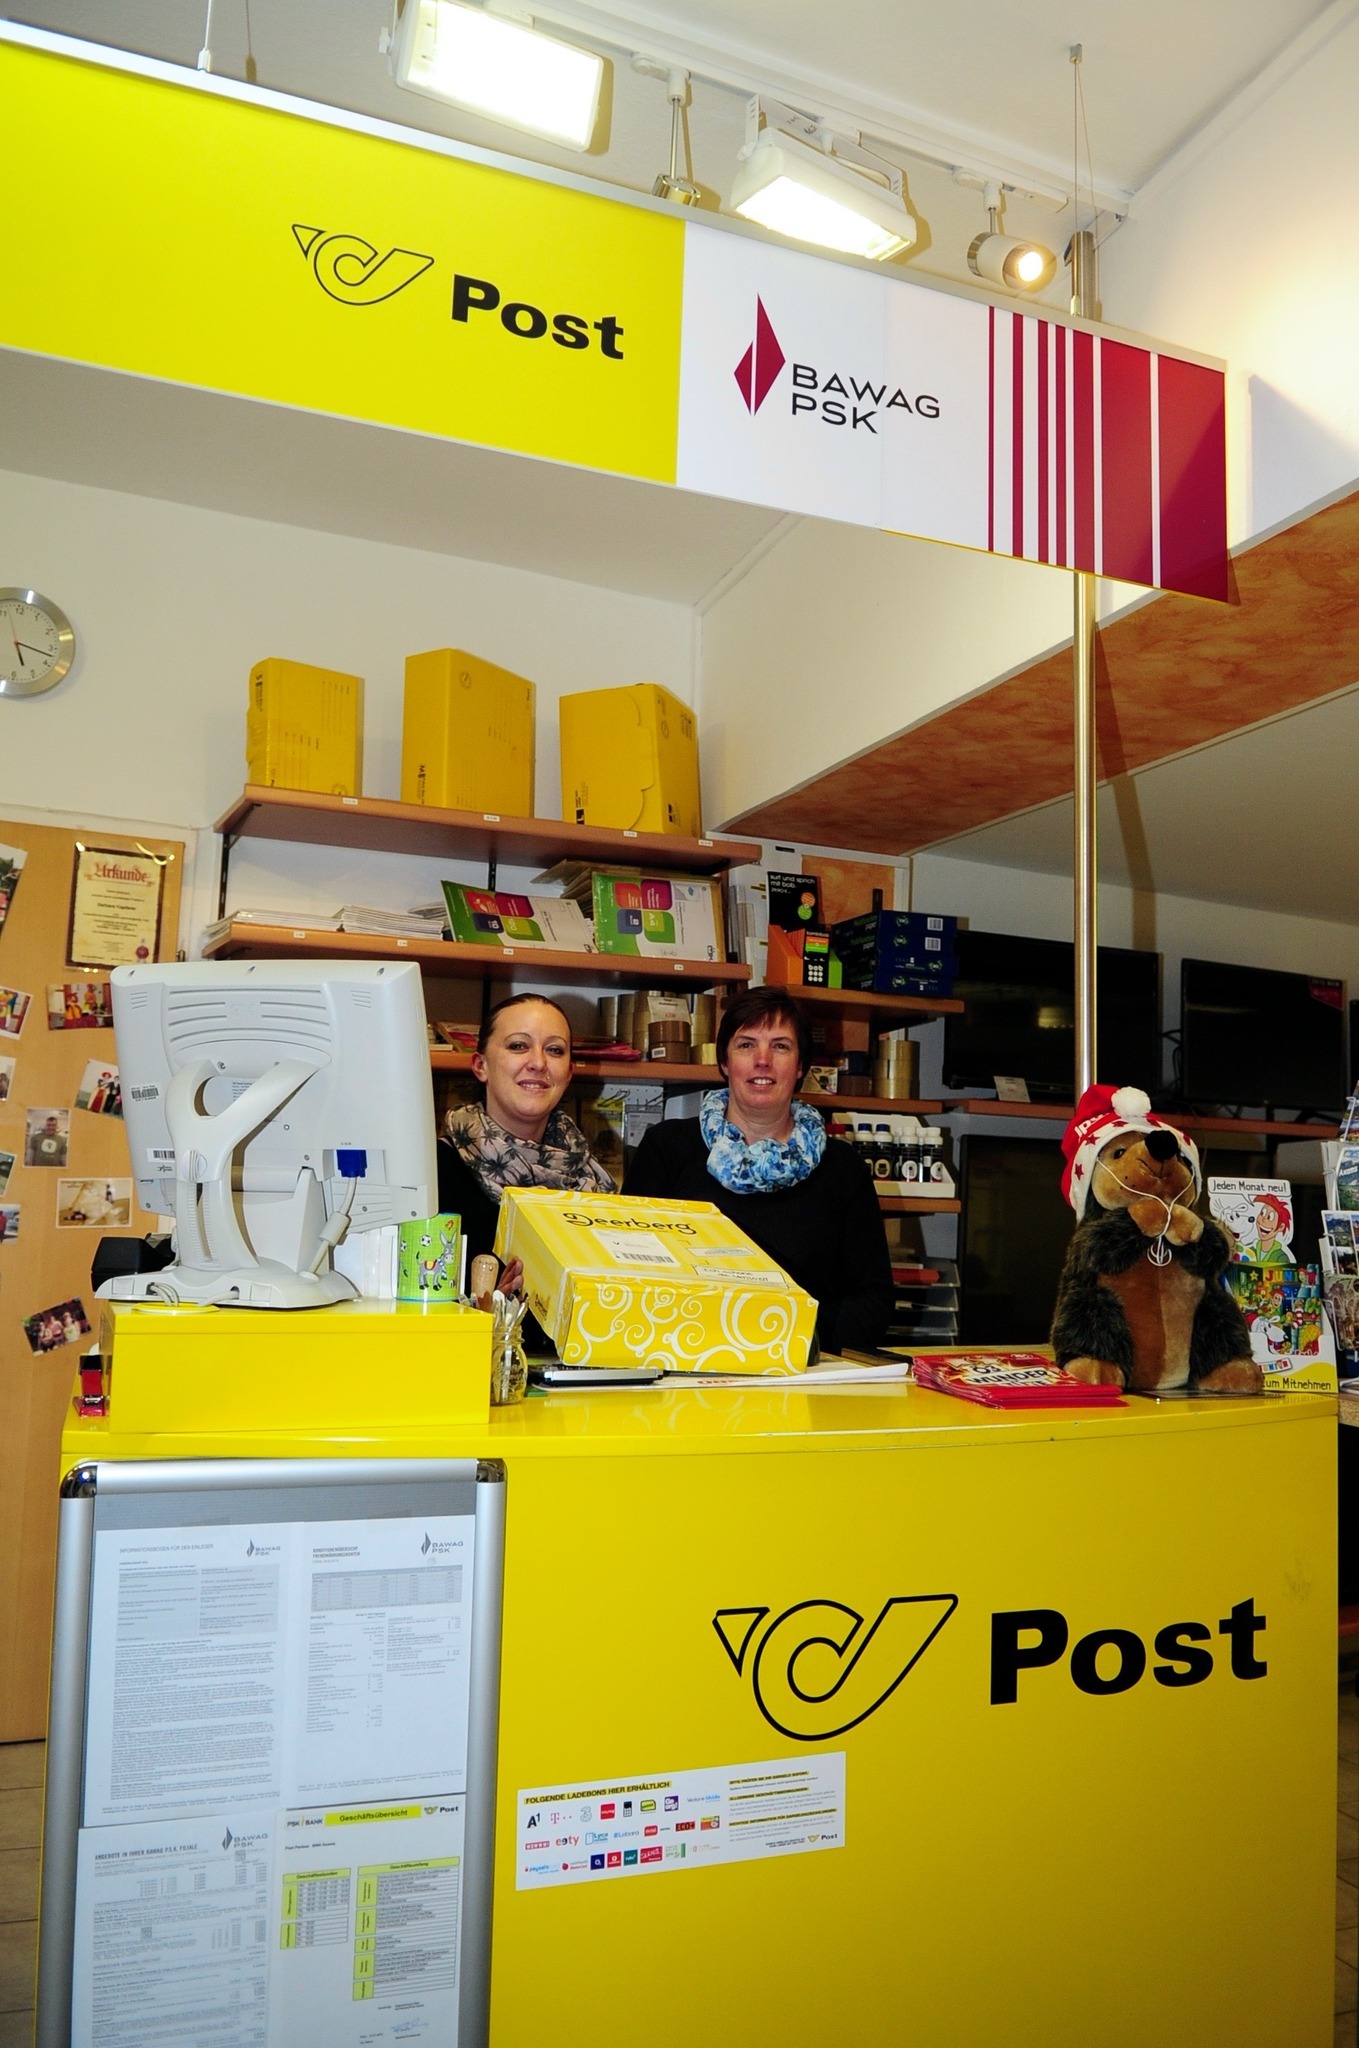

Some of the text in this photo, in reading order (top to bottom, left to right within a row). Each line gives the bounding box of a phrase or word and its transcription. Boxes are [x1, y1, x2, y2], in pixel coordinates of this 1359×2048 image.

[451, 274, 625, 360] Post
[792, 363, 940, 419] BAWAG
[791, 394, 879, 434] PSK
[94, 862, 150, 883] Urkunde
[1212, 1180, 1287, 1193] Jeden Monat neu!
[1282, 1377, 1332, 1390] Mitnehmen
[431, 1540, 464, 1548] BAWAG
[989, 1596, 1268, 1706] Post
[525, 1781, 670, 1805] FOLGENDE LADEBONS HIER ERHÄLTLICH
[339, 1808, 408, 1823] Geschäftsübersicht
[439, 1805, 459, 1814] Post
[287, 1817, 323, 1827] PSK BANK
[233, 1832, 269, 1843] BAWAG
[233, 1840, 254, 1849] PSK
